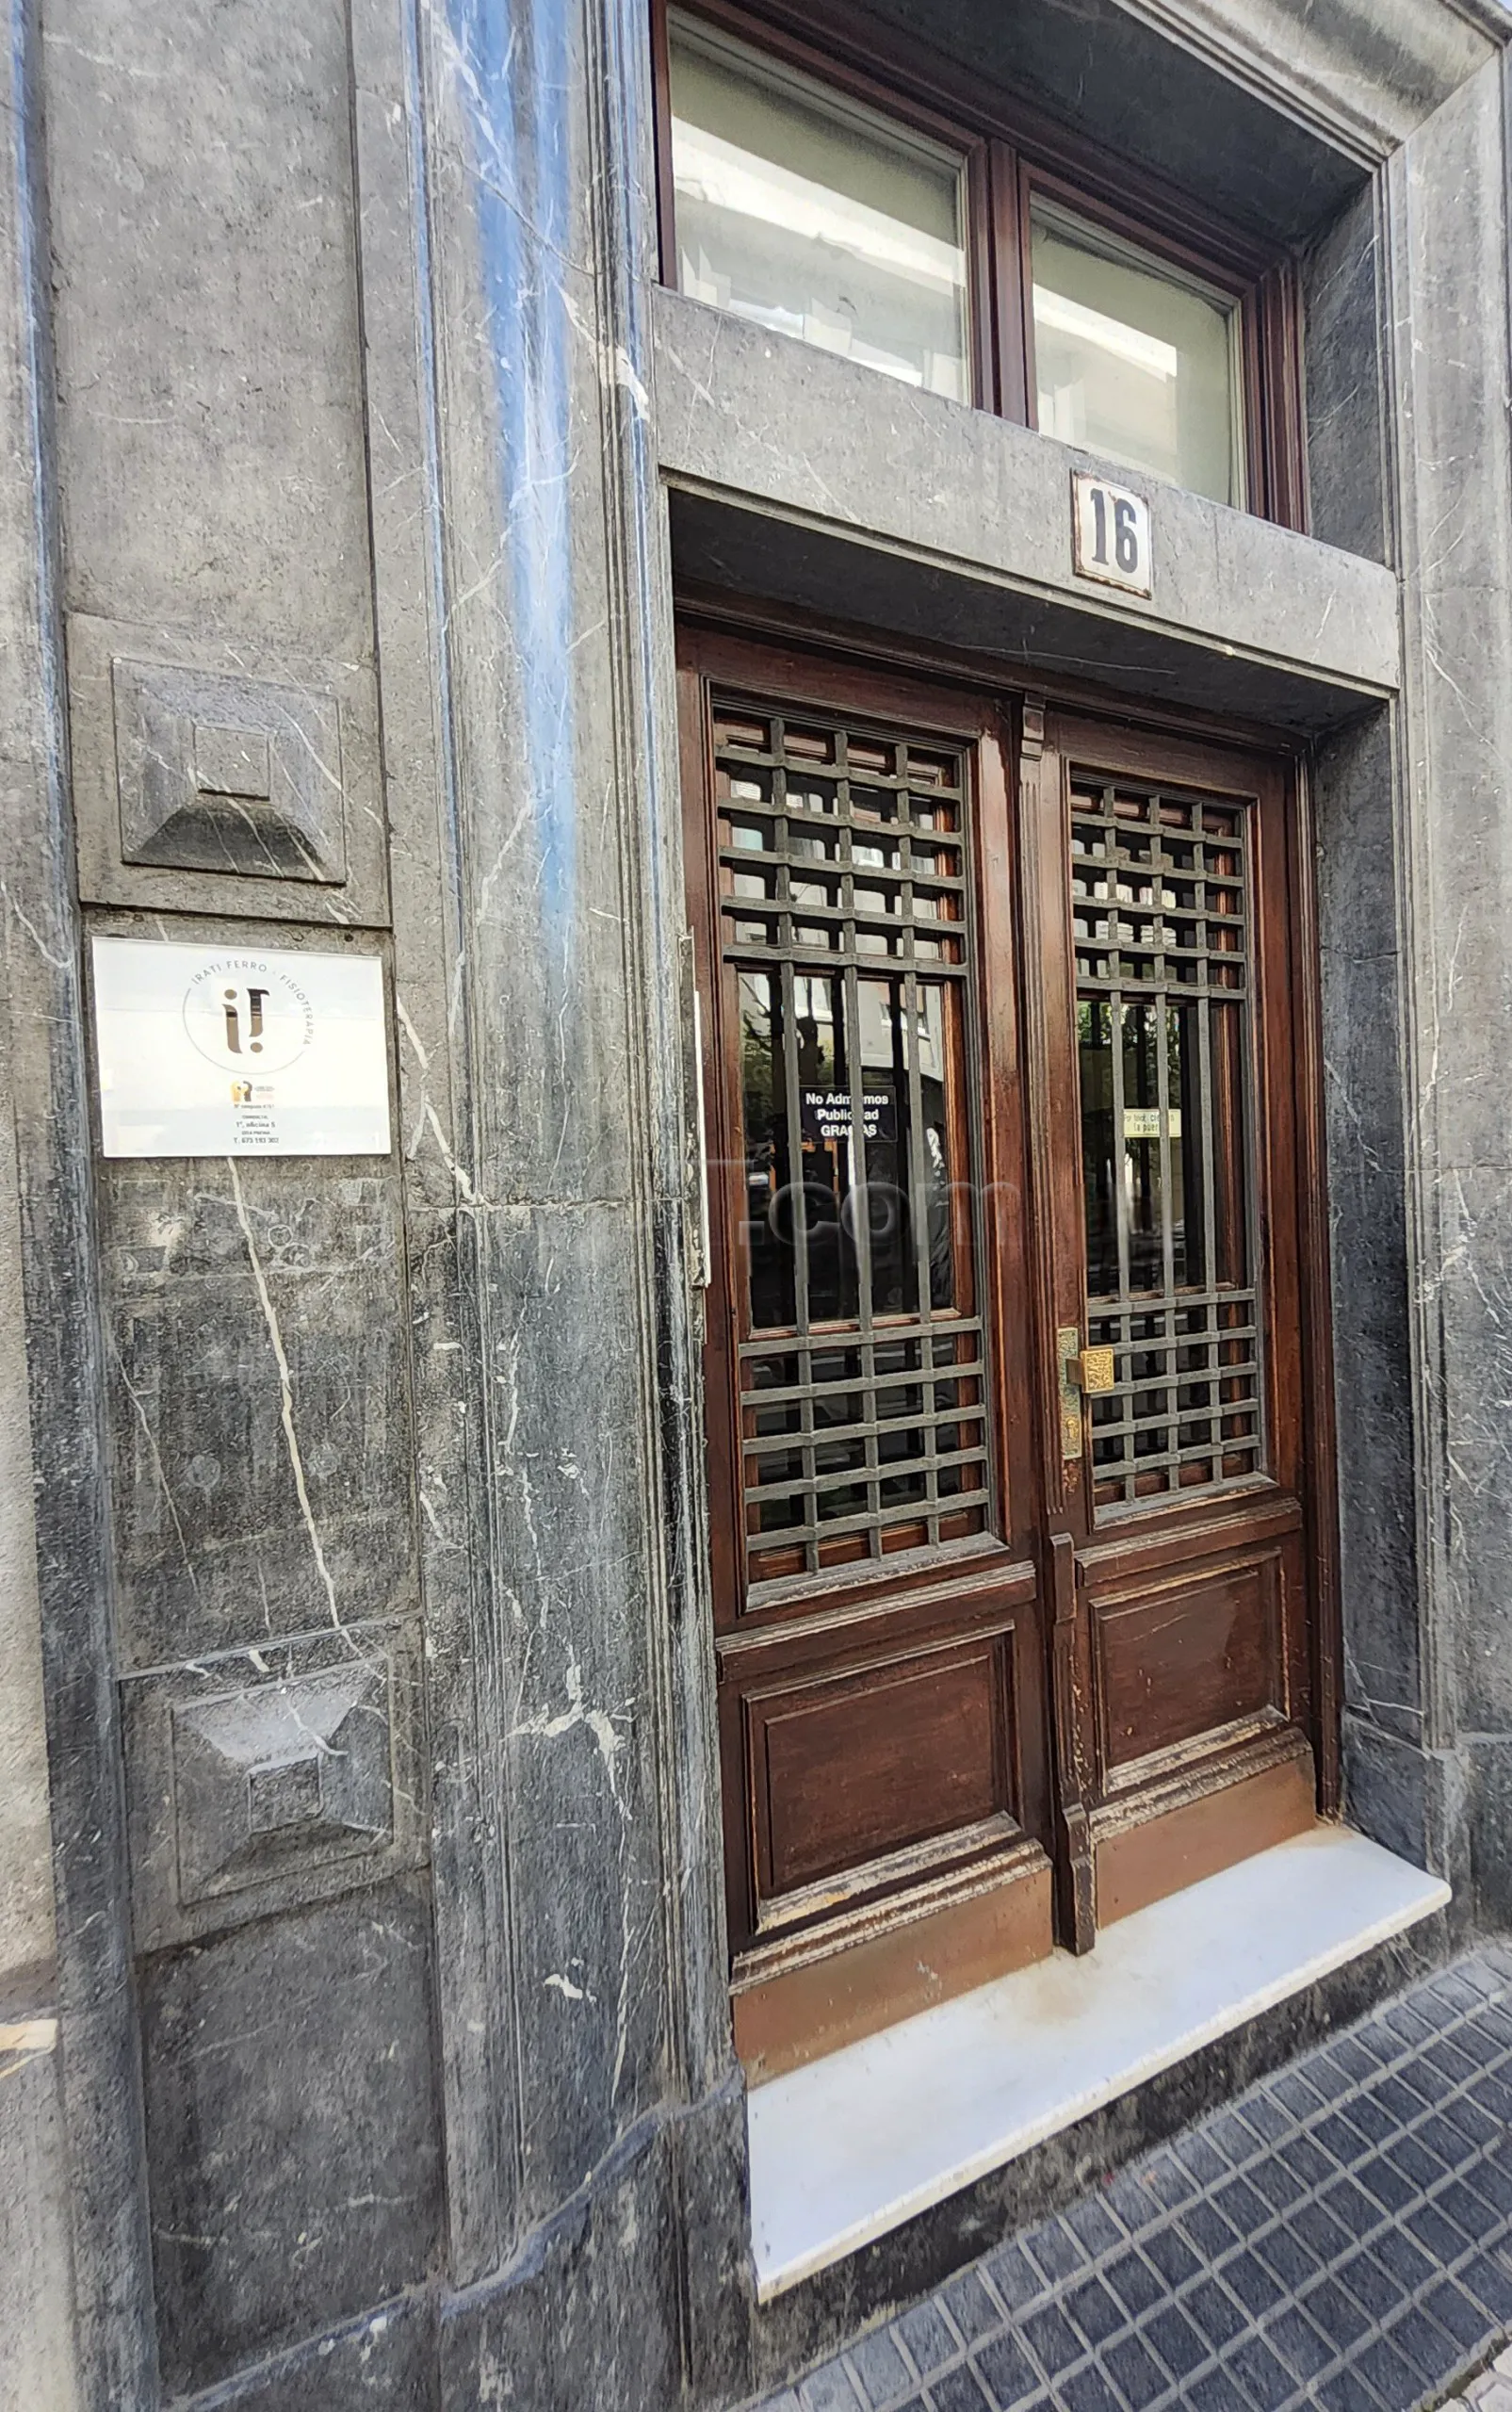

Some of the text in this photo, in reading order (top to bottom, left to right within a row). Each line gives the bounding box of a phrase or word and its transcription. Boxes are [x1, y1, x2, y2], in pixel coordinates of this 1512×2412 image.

[1090, 487, 1138, 574] 16
[191, 959, 316, 1046] IRATI FERRO FISIOTERAPIA
[805, 1093, 889, 1105] No Admmos
